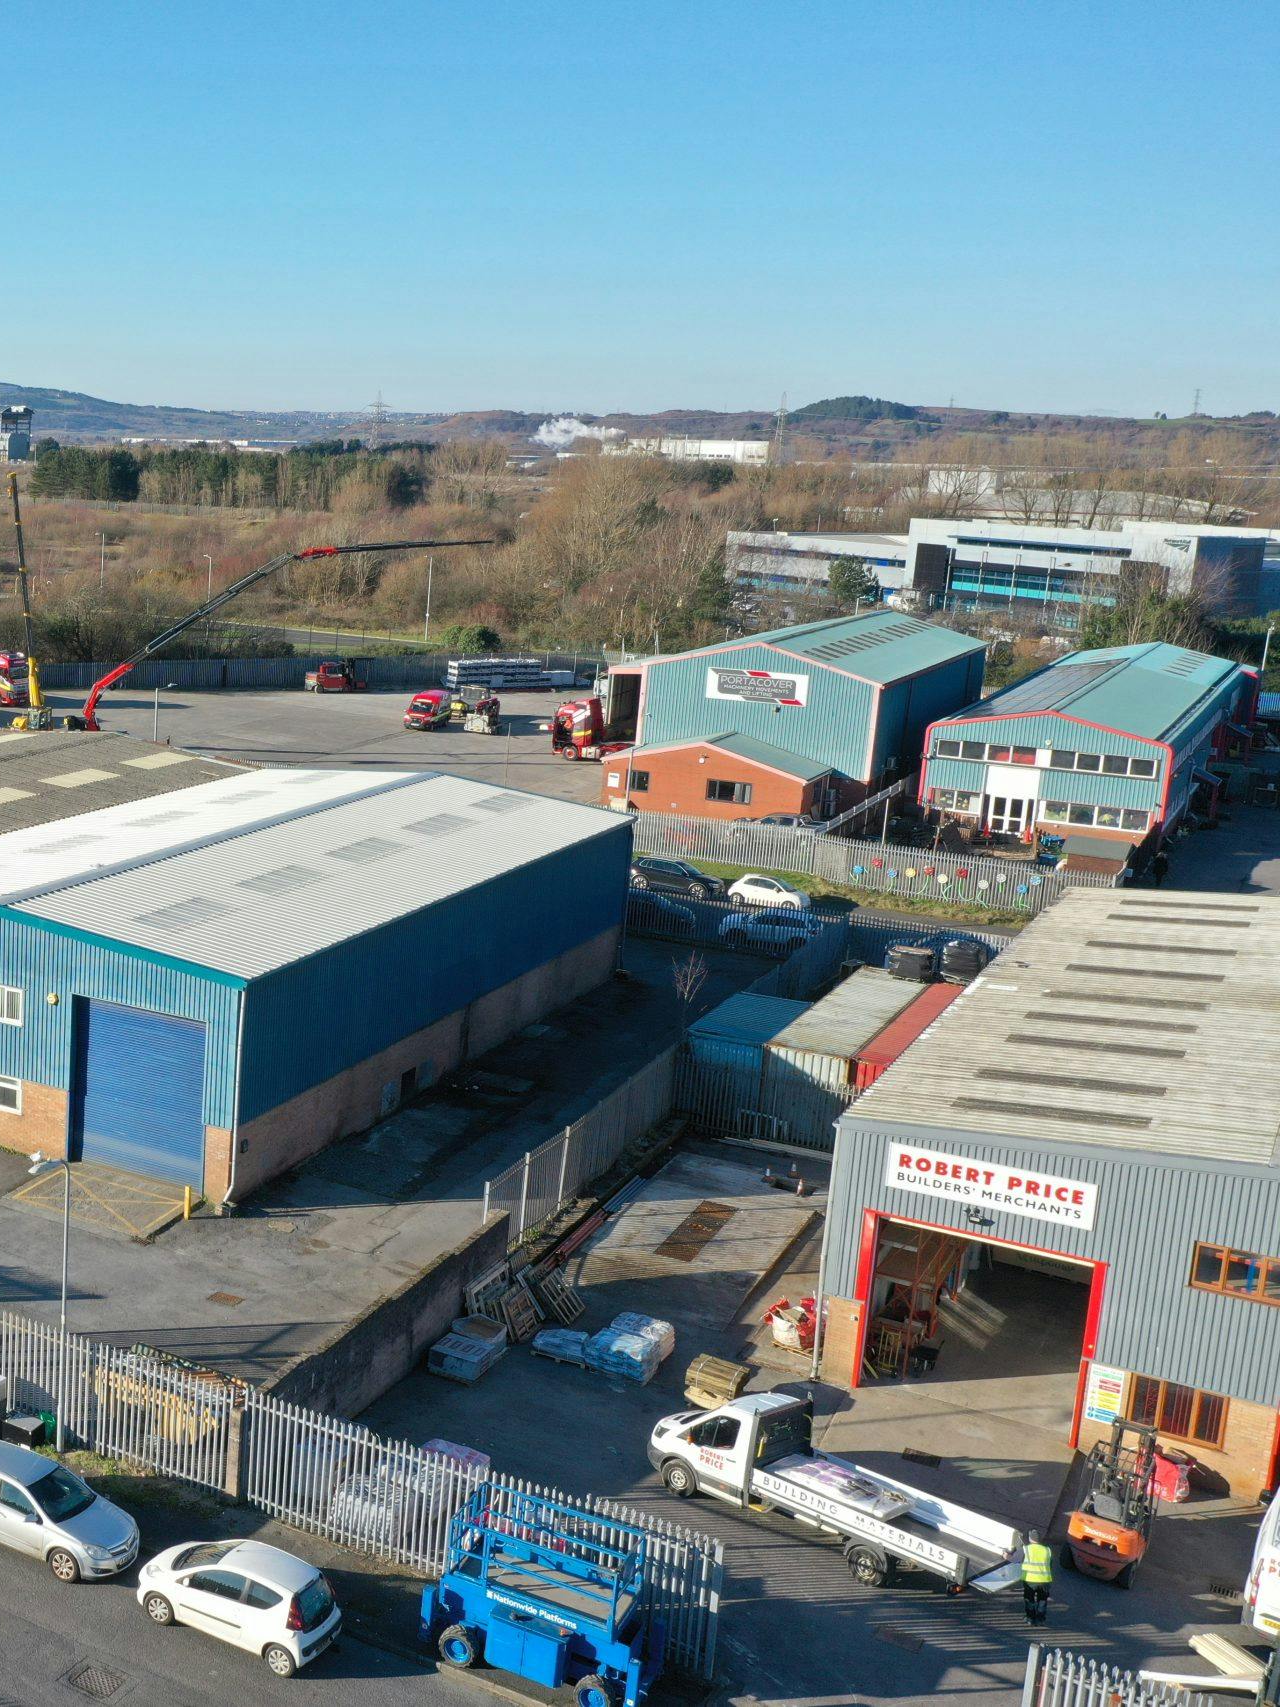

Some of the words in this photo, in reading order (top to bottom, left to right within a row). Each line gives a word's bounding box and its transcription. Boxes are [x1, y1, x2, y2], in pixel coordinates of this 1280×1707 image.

[720, 675, 793, 689] PORTACOVER
[724, 684, 754, 692] MACHINERY
[756, 686, 789, 695] MOVEMENTS
[897, 1171, 976, 1195] BUILDERS'
[981, 1190, 1081, 1219] MERCHANTS
[899, 1153, 995, 1186] ROBERT
[1007, 1176, 1085, 1205] PRICE
[699, 1454, 724, 1471] PRICE
[700, 1447, 724, 1461] ROBERT
[763, 1475, 840, 1515] BUILDING
[854, 1514, 945, 1562] MATERIALS
[493, 1592, 538, 1615] Nationwide
[538, 1610, 578, 1630] Platforms
